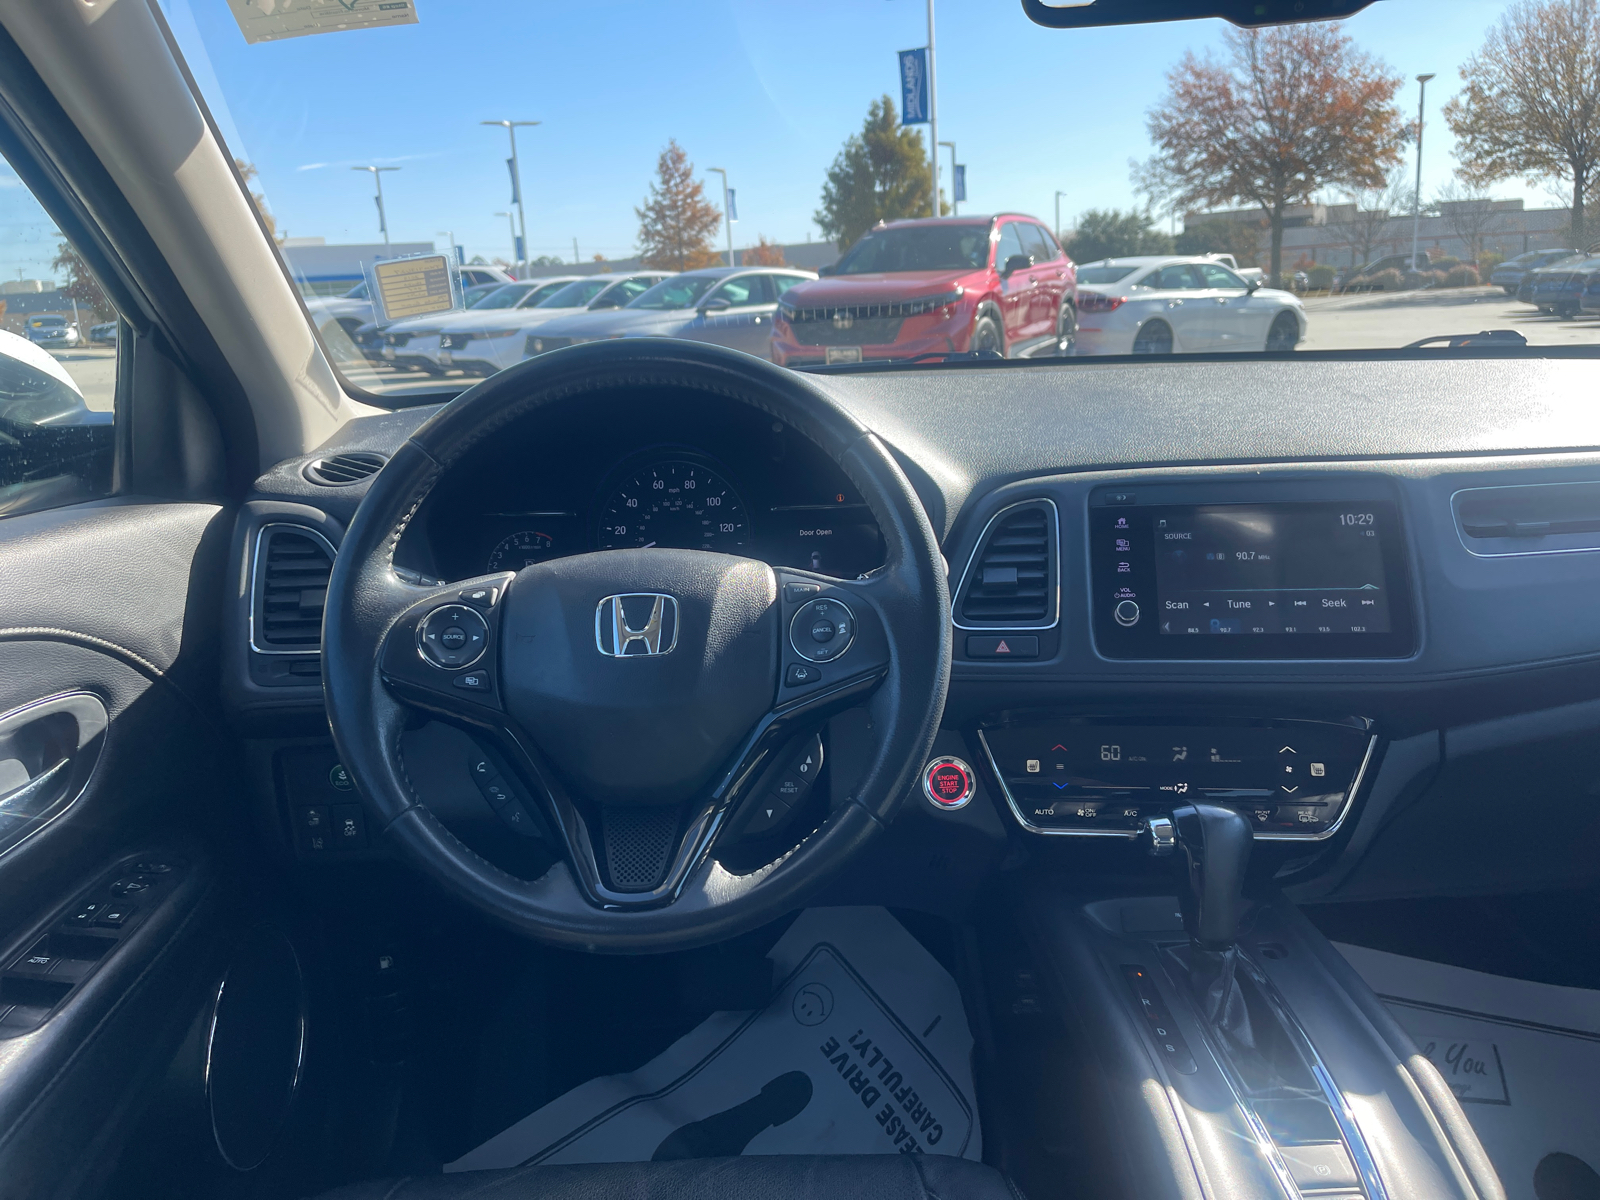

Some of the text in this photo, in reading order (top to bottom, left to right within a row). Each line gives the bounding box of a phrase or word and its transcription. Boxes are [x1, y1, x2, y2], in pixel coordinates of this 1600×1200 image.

[653, 480, 664, 489] 60
[685, 480, 695, 489] 80
[626, 498, 637, 507] 40
[706, 497, 721, 506] 100
[1340, 514, 1374, 526] 10:29
[615, 526, 626, 534] 20
[719, 523, 734, 532] 120
[1236, 551, 1255, 561] 90.7
[1165, 599, 1347, 609] Scan Tune Seek
[1101, 745, 1121, 761] 60
[1445, 1043, 1488, 1075] You
[819, 1036, 882, 1109] DRIVE
[848, 1029, 944, 1146] CAREFULLY!
